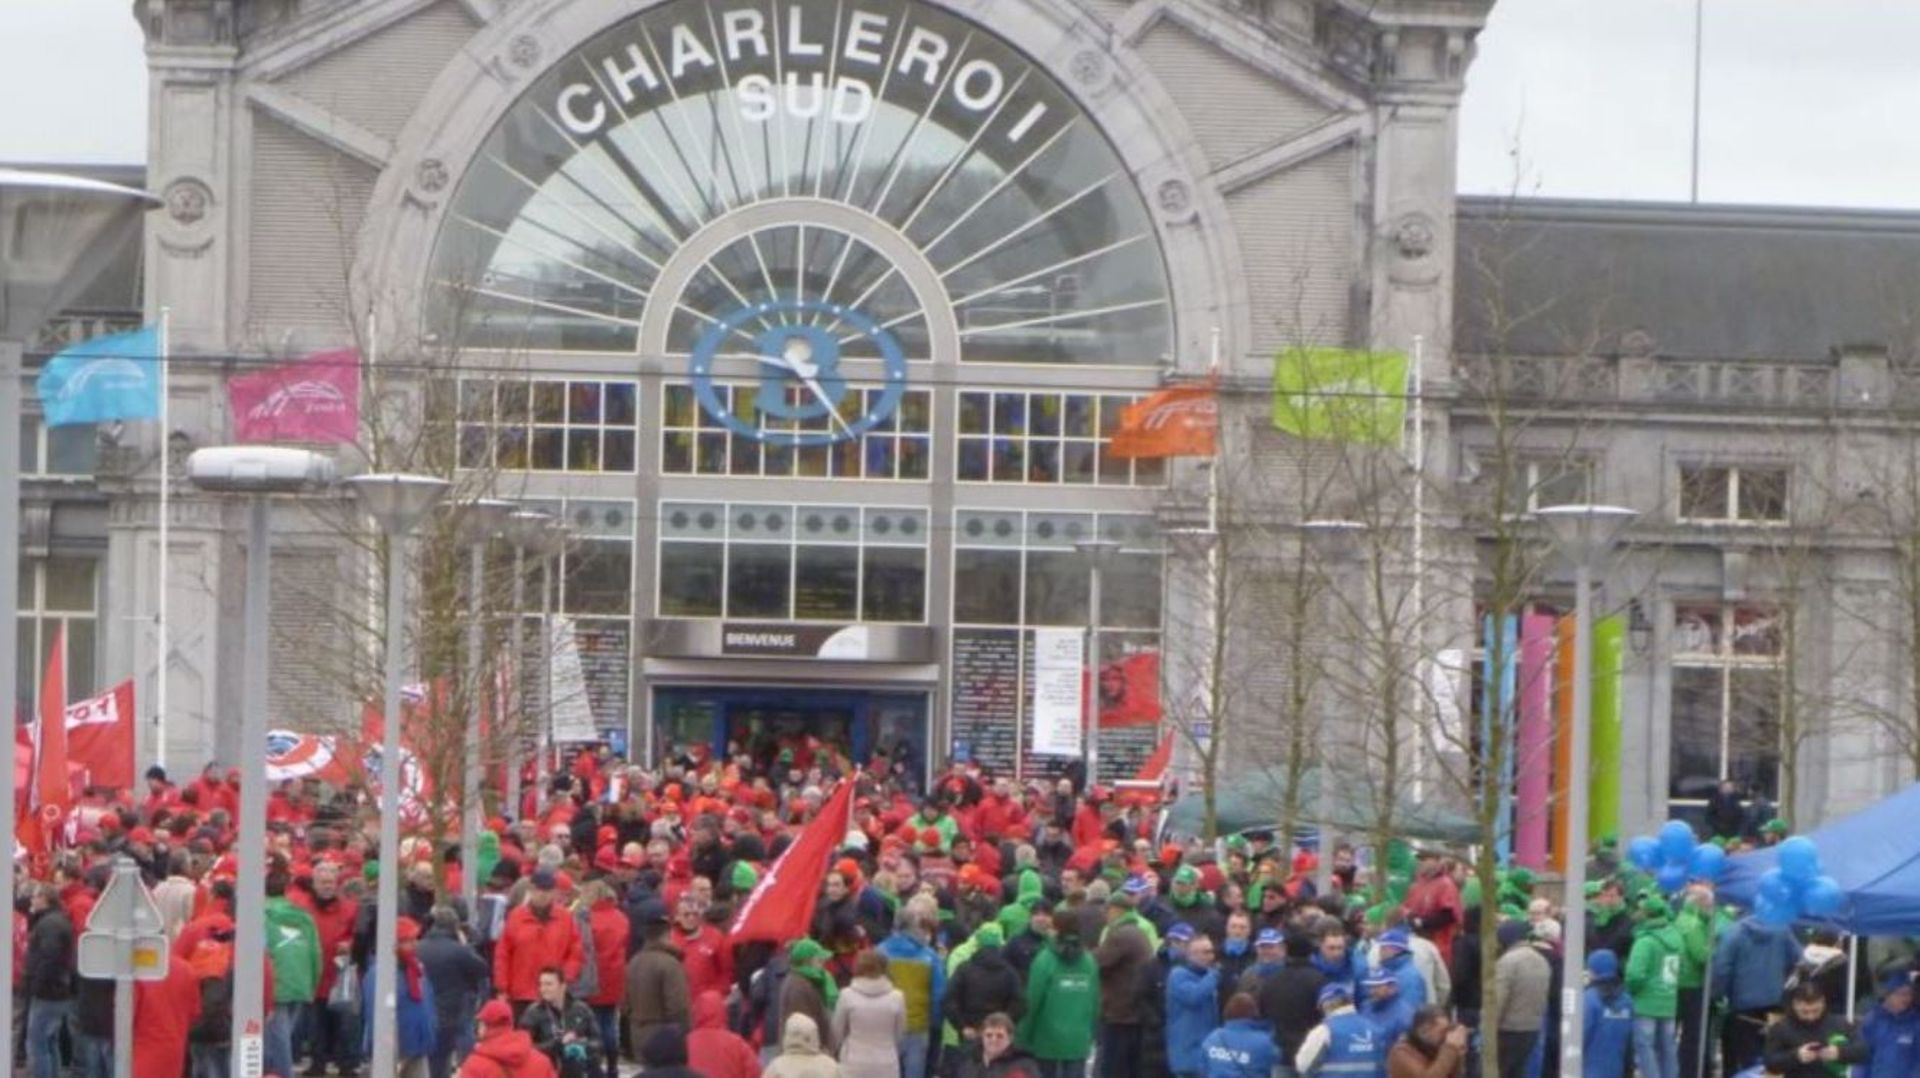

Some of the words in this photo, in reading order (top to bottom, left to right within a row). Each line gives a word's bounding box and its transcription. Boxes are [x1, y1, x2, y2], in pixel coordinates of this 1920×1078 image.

[556, 8, 1046, 142] CHARLEROI
[735, 71, 872, 124] SUD
[726, 633, 796, 647] BIENVENUE
